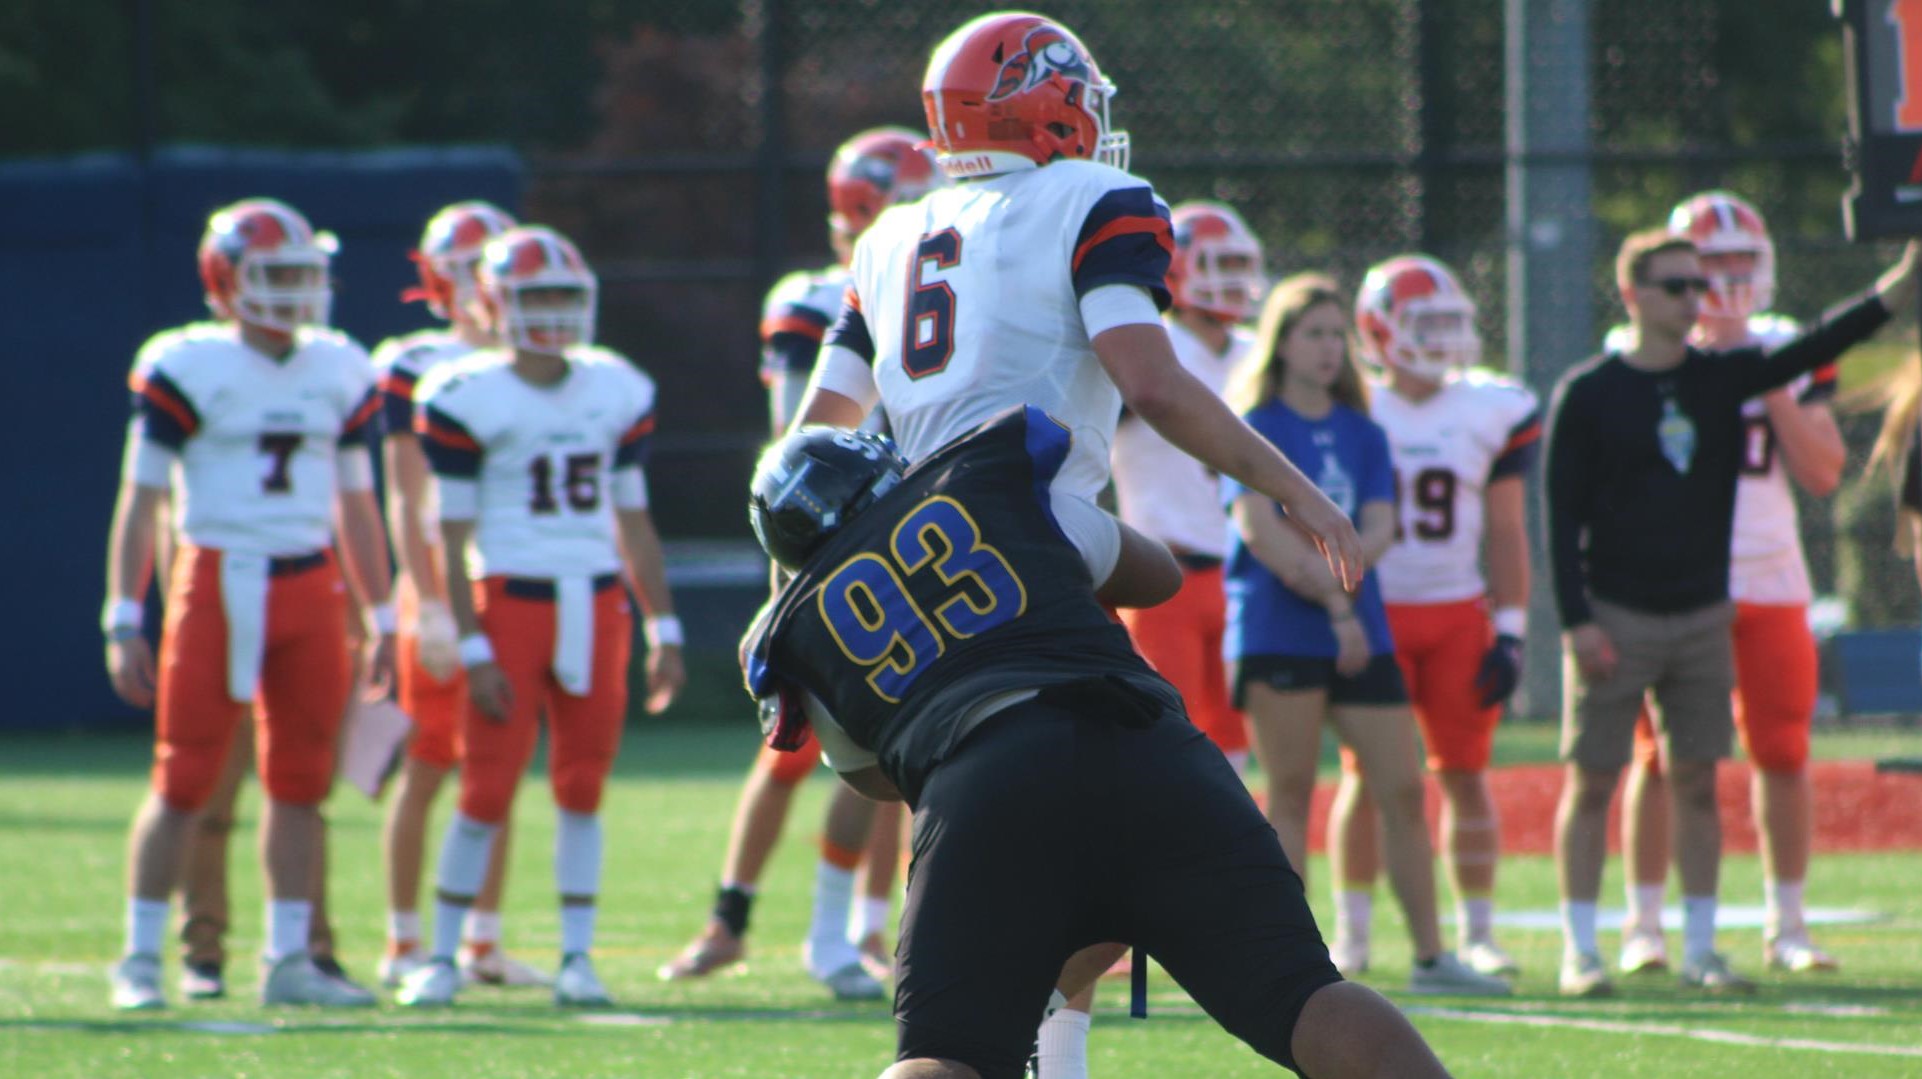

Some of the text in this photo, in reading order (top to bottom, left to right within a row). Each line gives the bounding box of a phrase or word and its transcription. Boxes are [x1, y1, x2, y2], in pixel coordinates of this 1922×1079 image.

[944, 154, 994, 176] ddell
[902, 226, 963, 382] 6
[257, 431, 305, 494] 7
[528, 452, 602, 514] 15
[818, 495, 1028, 704] 93
